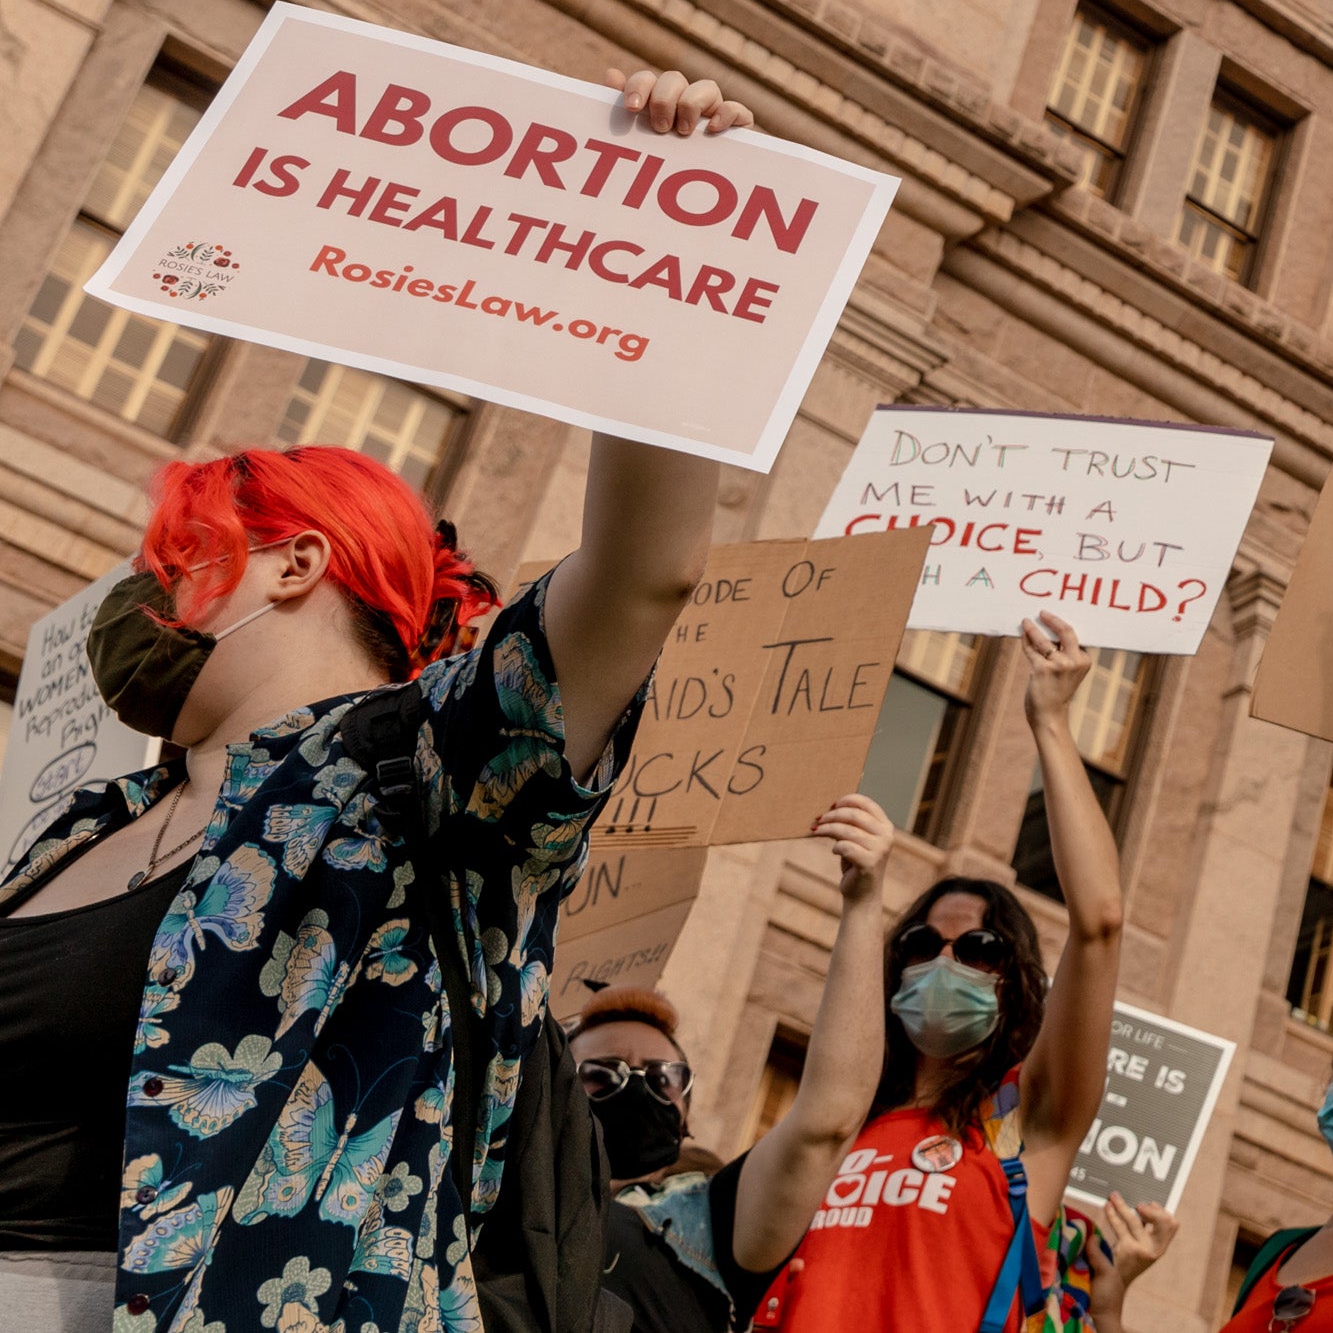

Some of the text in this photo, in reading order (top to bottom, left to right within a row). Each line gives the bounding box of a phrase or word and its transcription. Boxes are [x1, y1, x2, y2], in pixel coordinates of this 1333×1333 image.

[279, 70, 818, 256] ABORTION
[232, 146, 779, 324] IS HEALTHCARE
[159, 258, 234, 283] ROSIES LAW
[309, 244, 649, 362] RosiesLaw.org
[889, 429, 1196, 483] DON'T TRUST
[860, 481, 1118, 523] ME WITH A
[1072, 532, 1185, 568] BUT
[693, 560, 836, 606] ODE OF
[921, 564, 1207, 622] H A CHILD?
[676, 622, 710, 643] HE
[648, 637, 880, 721] AID'S TALE
[1111, 1020, 1165, 1051] OR LIFE
[1107, 1047, 1187, 1095] RE IS
[1079, 1118, 1177, 1182] ION
[826, 1168, 957, 1215] OICE
[810, 1206, 874, 1231] ROUD
